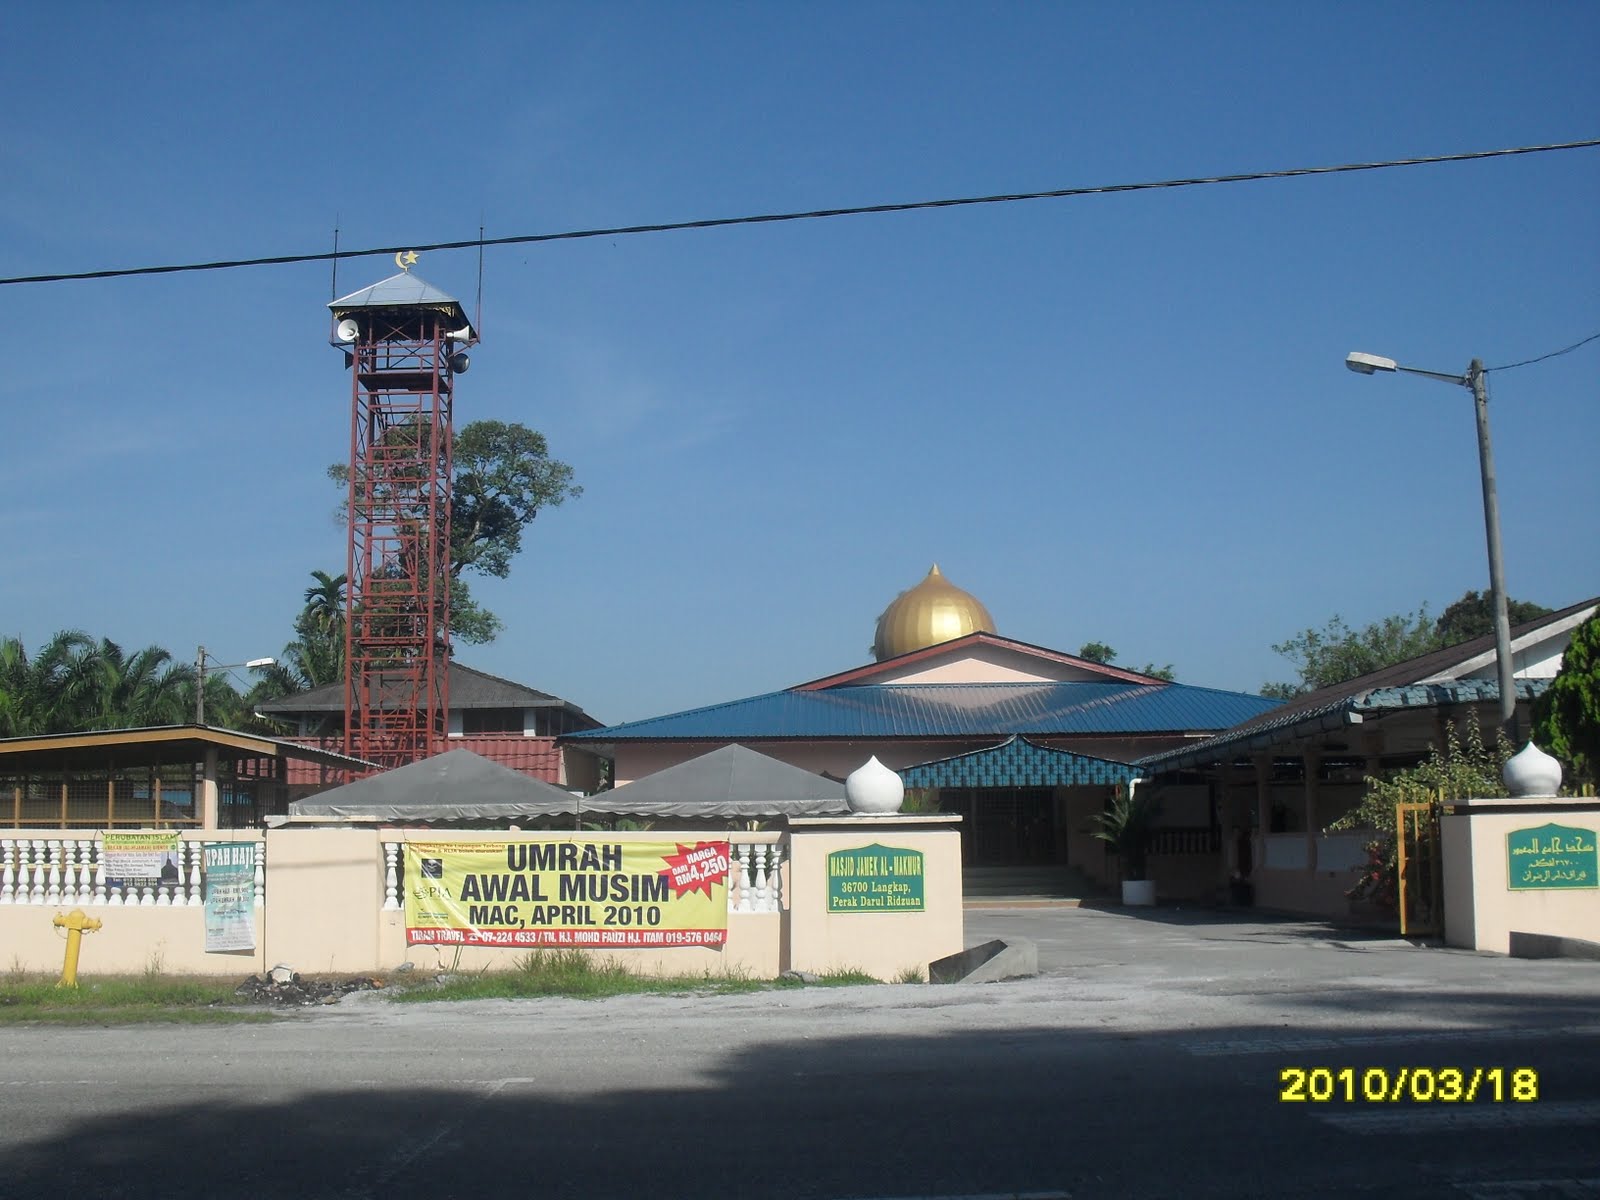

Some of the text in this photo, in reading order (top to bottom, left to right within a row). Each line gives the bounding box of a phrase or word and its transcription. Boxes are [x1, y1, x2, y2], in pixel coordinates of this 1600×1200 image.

[1542, 837, 1564, 854] جامع
[1566, 836, 1594, 854] مسجد
[205, 847, 254, 870] UPAH HAJI
[507, 844, 622, 872] UMRAH
[686, 847, 717, 864] HARGA
[672, 864, 688, 875] DARI
[675, 855, 727, 886] RM4,250
[831, 856, 854, 877] MASJID
[856, 856, 878, 876] JAMEK
[460, 874, 669, 902] AWAL MUSIM
[842, 881, 911, 895] 36700 Langkap,
[833, 895, 920, 906] Perak Darul Ridzuan
[470, 906, 660, 929] MAC, APRIL 2010
[436, 930, 465, 942] TRAVEL
[482, 932, 513, 942] 07-224
[514, 932, 536, 942] 4533
[538, 932, 542, 942] /
[574, 932, 600, 942] MOHD
[602, 932, 625, 942] FAUZI
[643, 932, 663, 942] ITAM
[666, 932, 701, 942] 019-576
